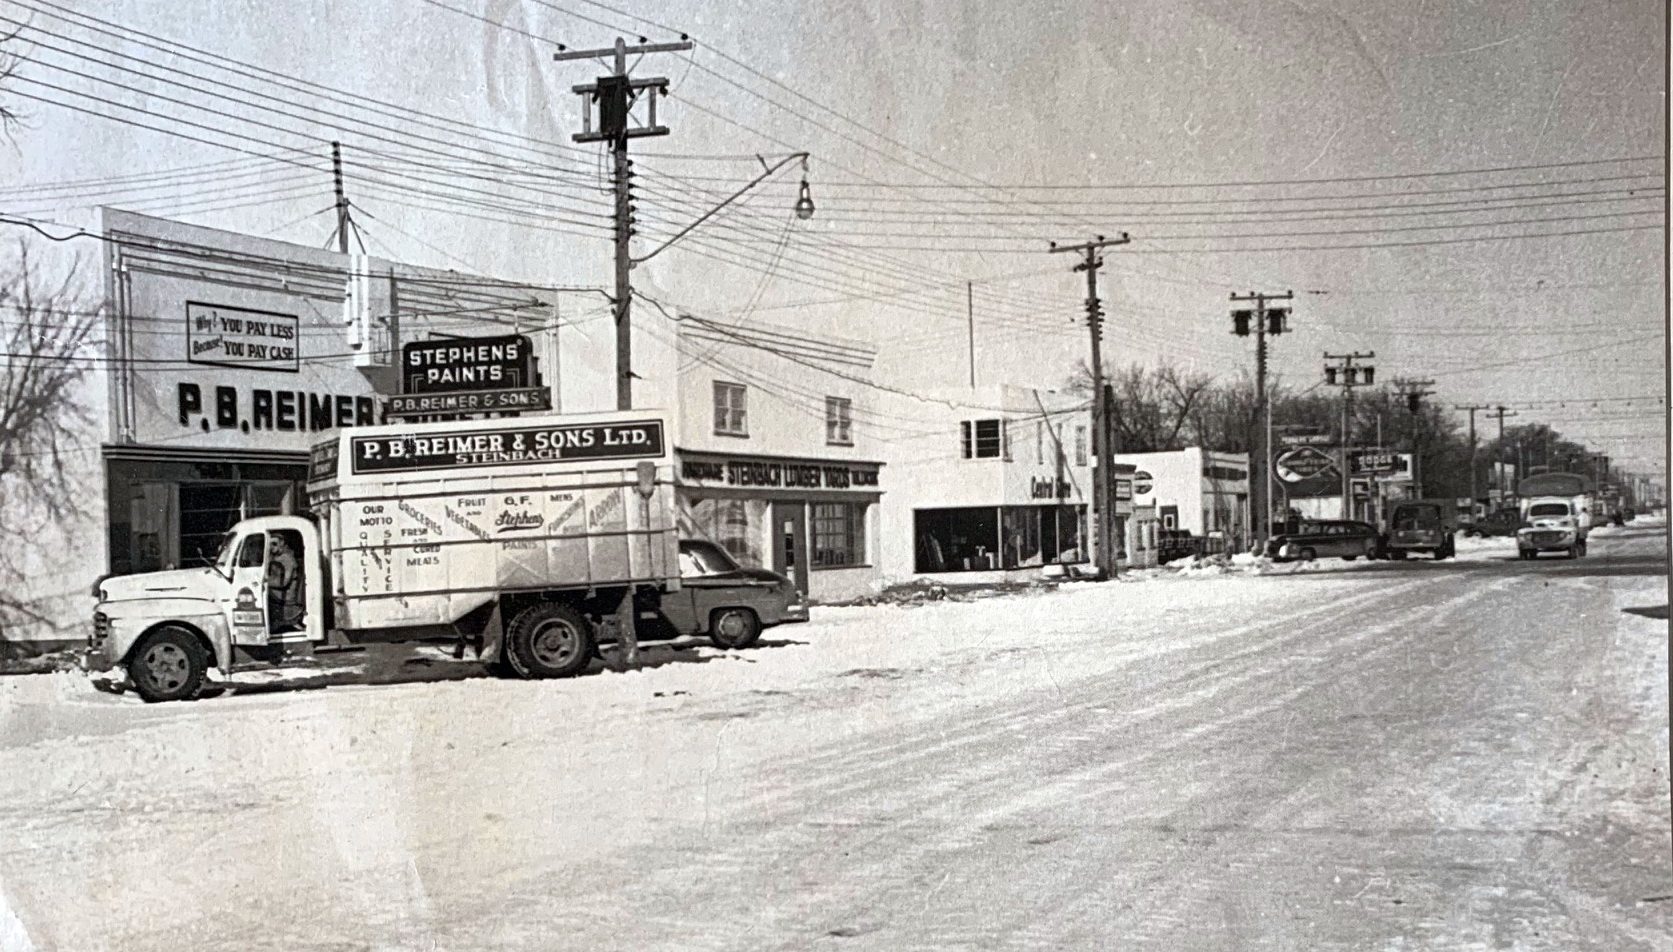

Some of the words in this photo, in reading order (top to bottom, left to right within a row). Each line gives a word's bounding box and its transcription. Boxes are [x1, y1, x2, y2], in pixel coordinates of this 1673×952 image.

[220, 317, 242, 333] YOU
[246, 320, 268, 336] PAY
[270, 323, 294, 340] LESS
[224, 341, 244, 357] YOU
[249, 344, 269, 359] PAY
[269, 345, 294, 361] CASH
[410, 344, 518, 366] STEPHENS
[427, 365, 503, 384] PAINTS
[253, 389, 374, 432] REIMER
[421, 395, 478, 410] REIMER
[484, 394, 495, 407] &
[500, 392, 539, 405] SONS
[414, 434, 504, 456] REIMER
[512, 433, 526, 450] &
[535, 429, 595, 450] SONS
[456, 449, 561, 465] STEINBACH
[362, 505, 384, 514] OUR
[458, 498, 486, 508] FRUIT
[360, 517, 393, 526] MOTTO
[445, 504, 491, 541] VEGETABLE
[495, 510, 544, 531] Stephens
[401, 528, 428, 537] FRESH
[383, 530, 393, 591] SERVICE
[406, 556, 440, 567] MEATS
